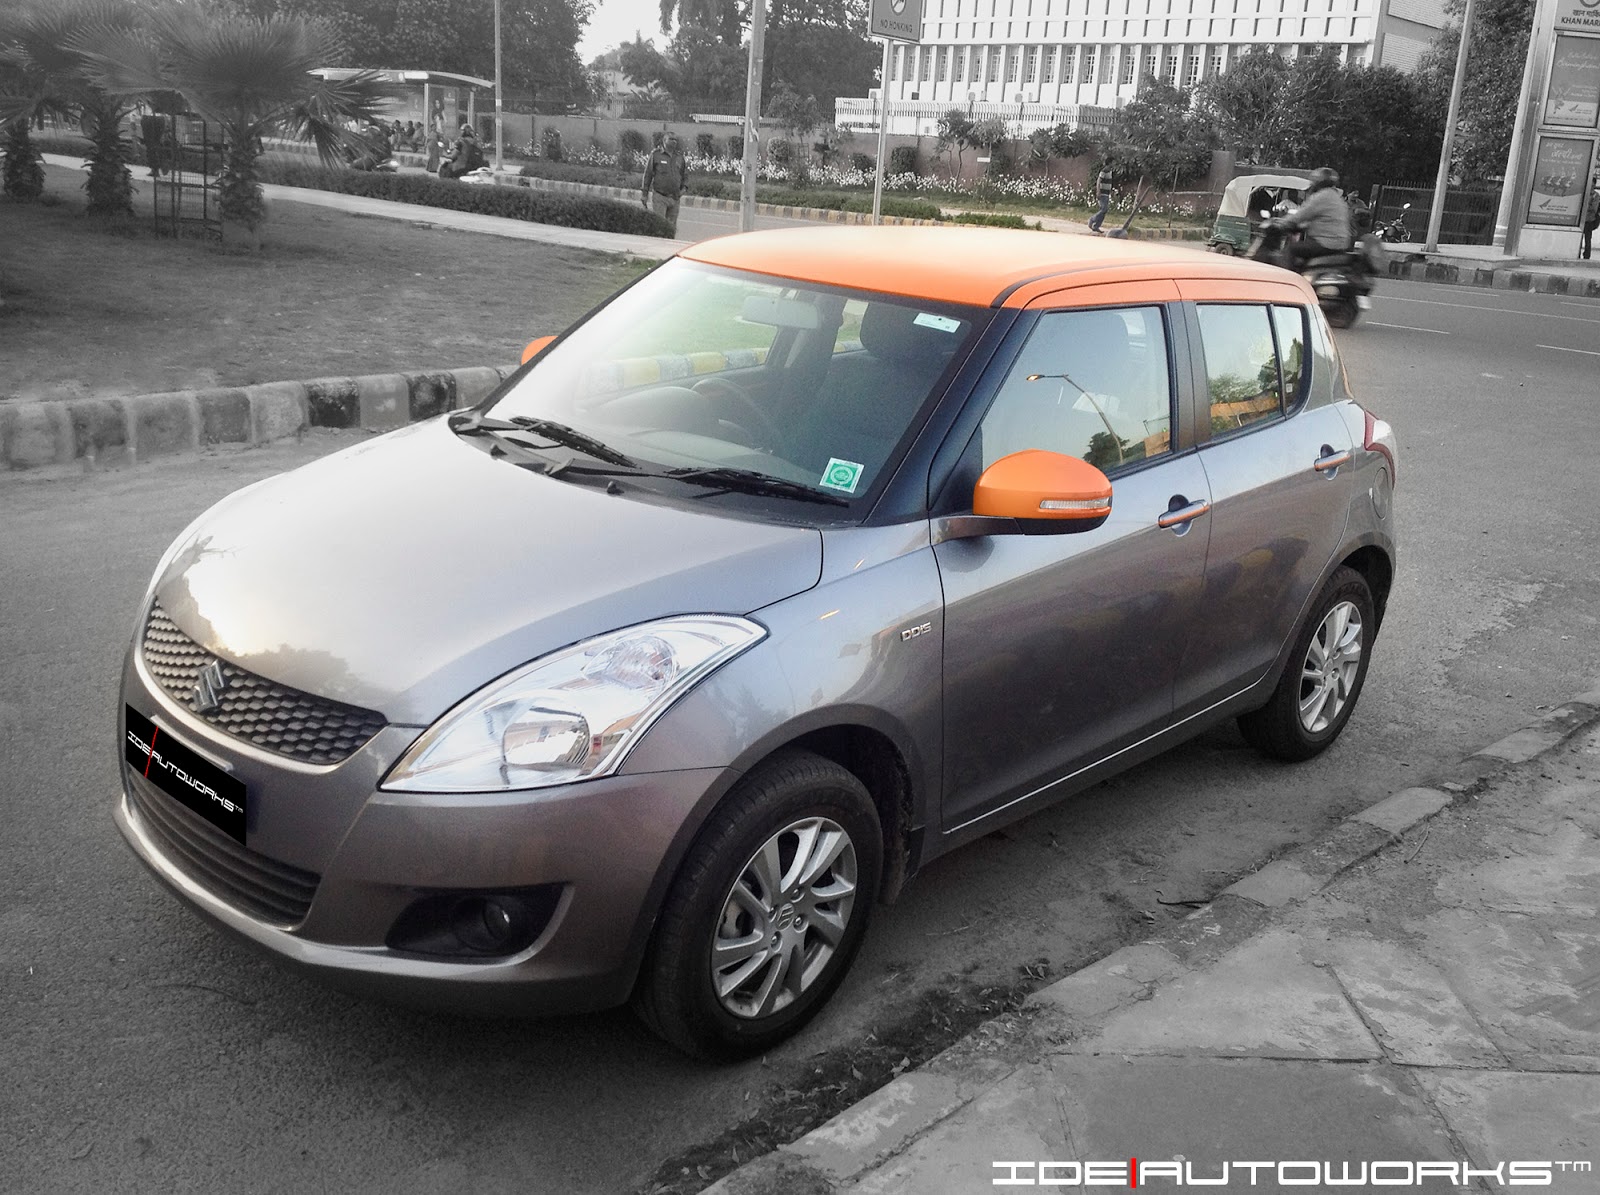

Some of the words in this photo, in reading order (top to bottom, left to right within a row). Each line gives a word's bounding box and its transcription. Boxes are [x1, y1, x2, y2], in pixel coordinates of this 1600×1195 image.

[880, 19, 888, 28] NO
[889, 20, 913, 33] HONKING
[1560, 16, 1582, 25] KHAN
[1582, 18, 1600, 27] MAR
